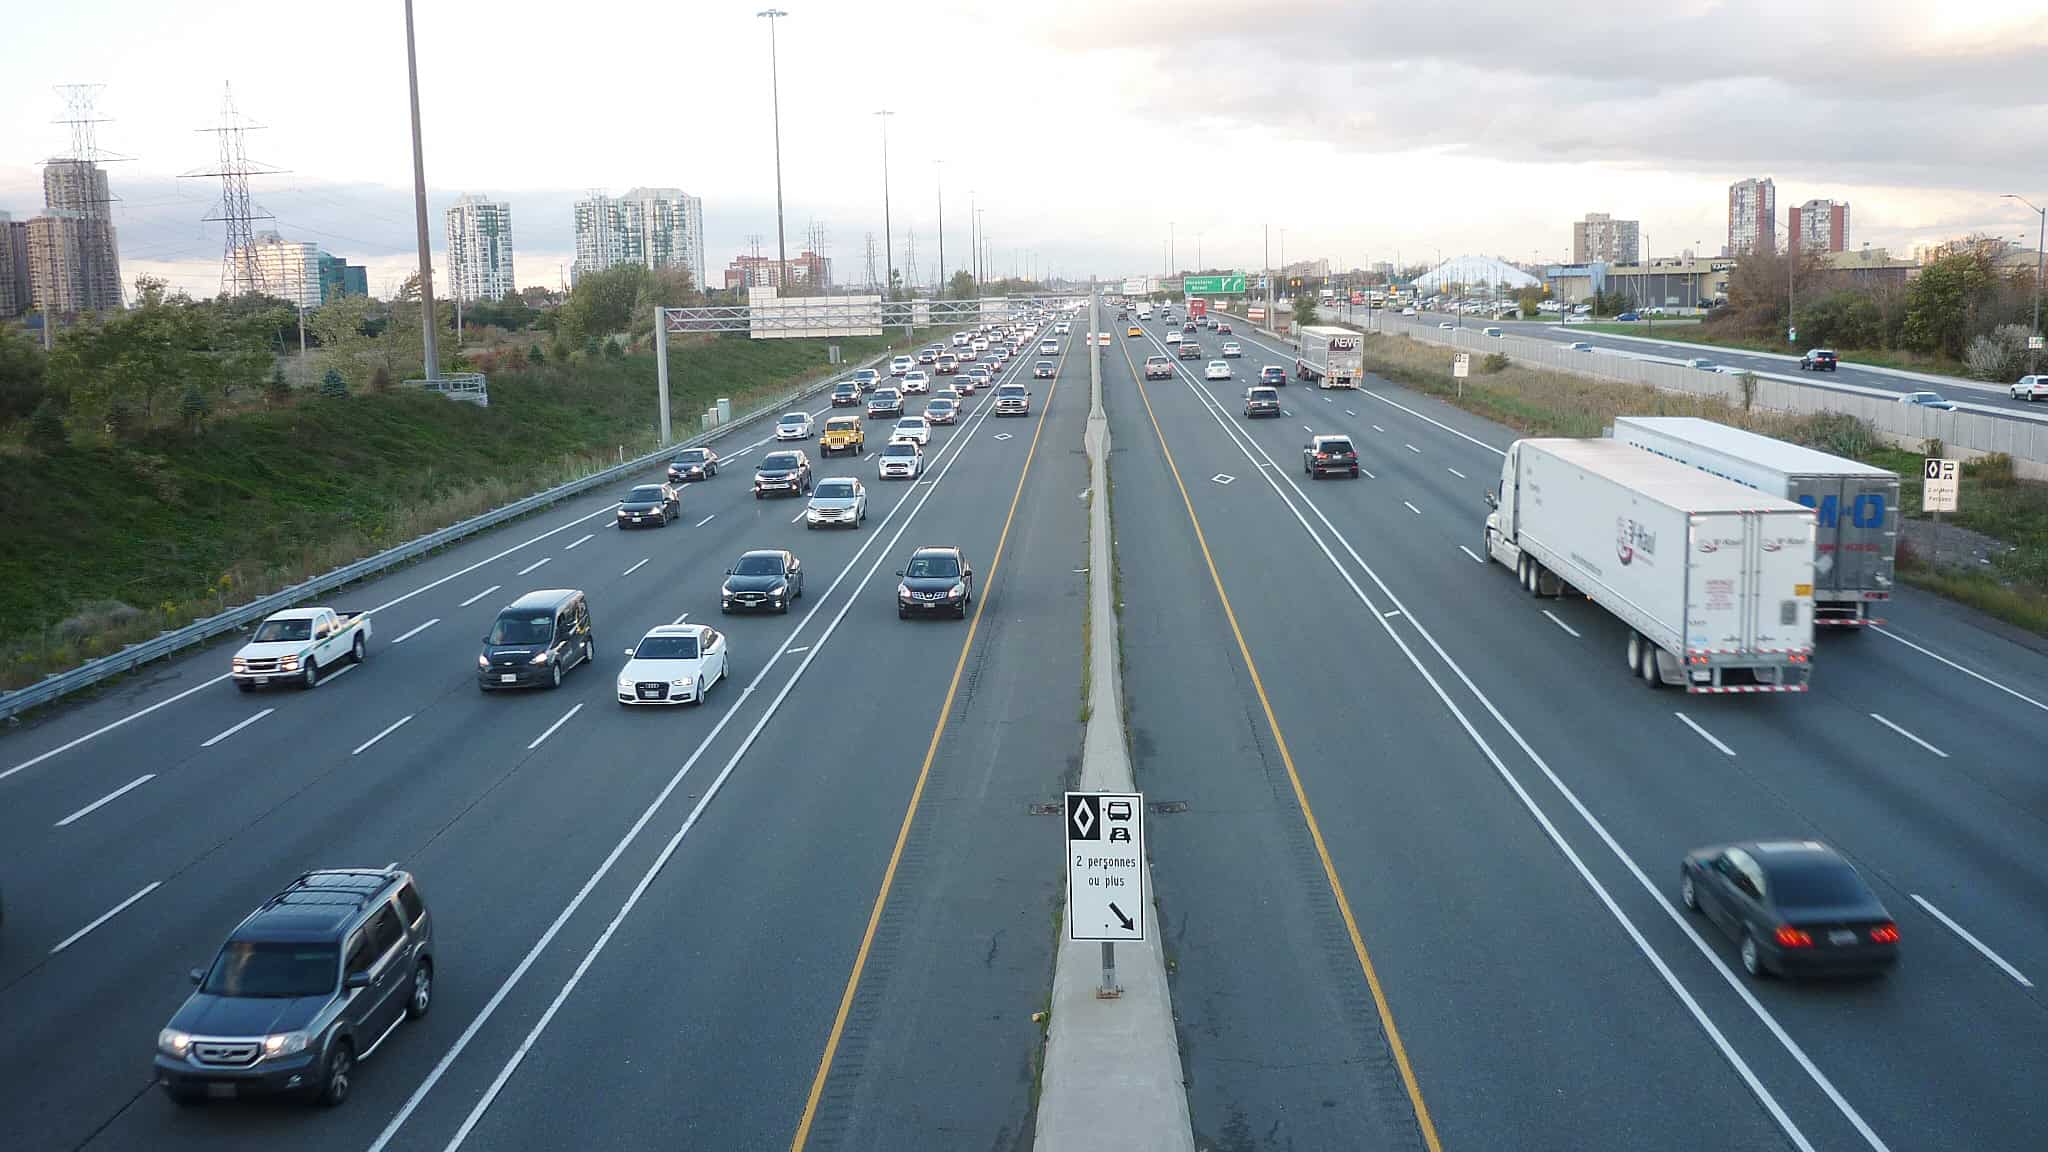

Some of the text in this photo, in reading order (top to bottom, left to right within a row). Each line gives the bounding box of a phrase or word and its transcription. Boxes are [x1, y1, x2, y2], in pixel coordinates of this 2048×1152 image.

[1076, 855, 1136, 869] 2 personnes
[1088, 875, 1125, 889] ou plus
